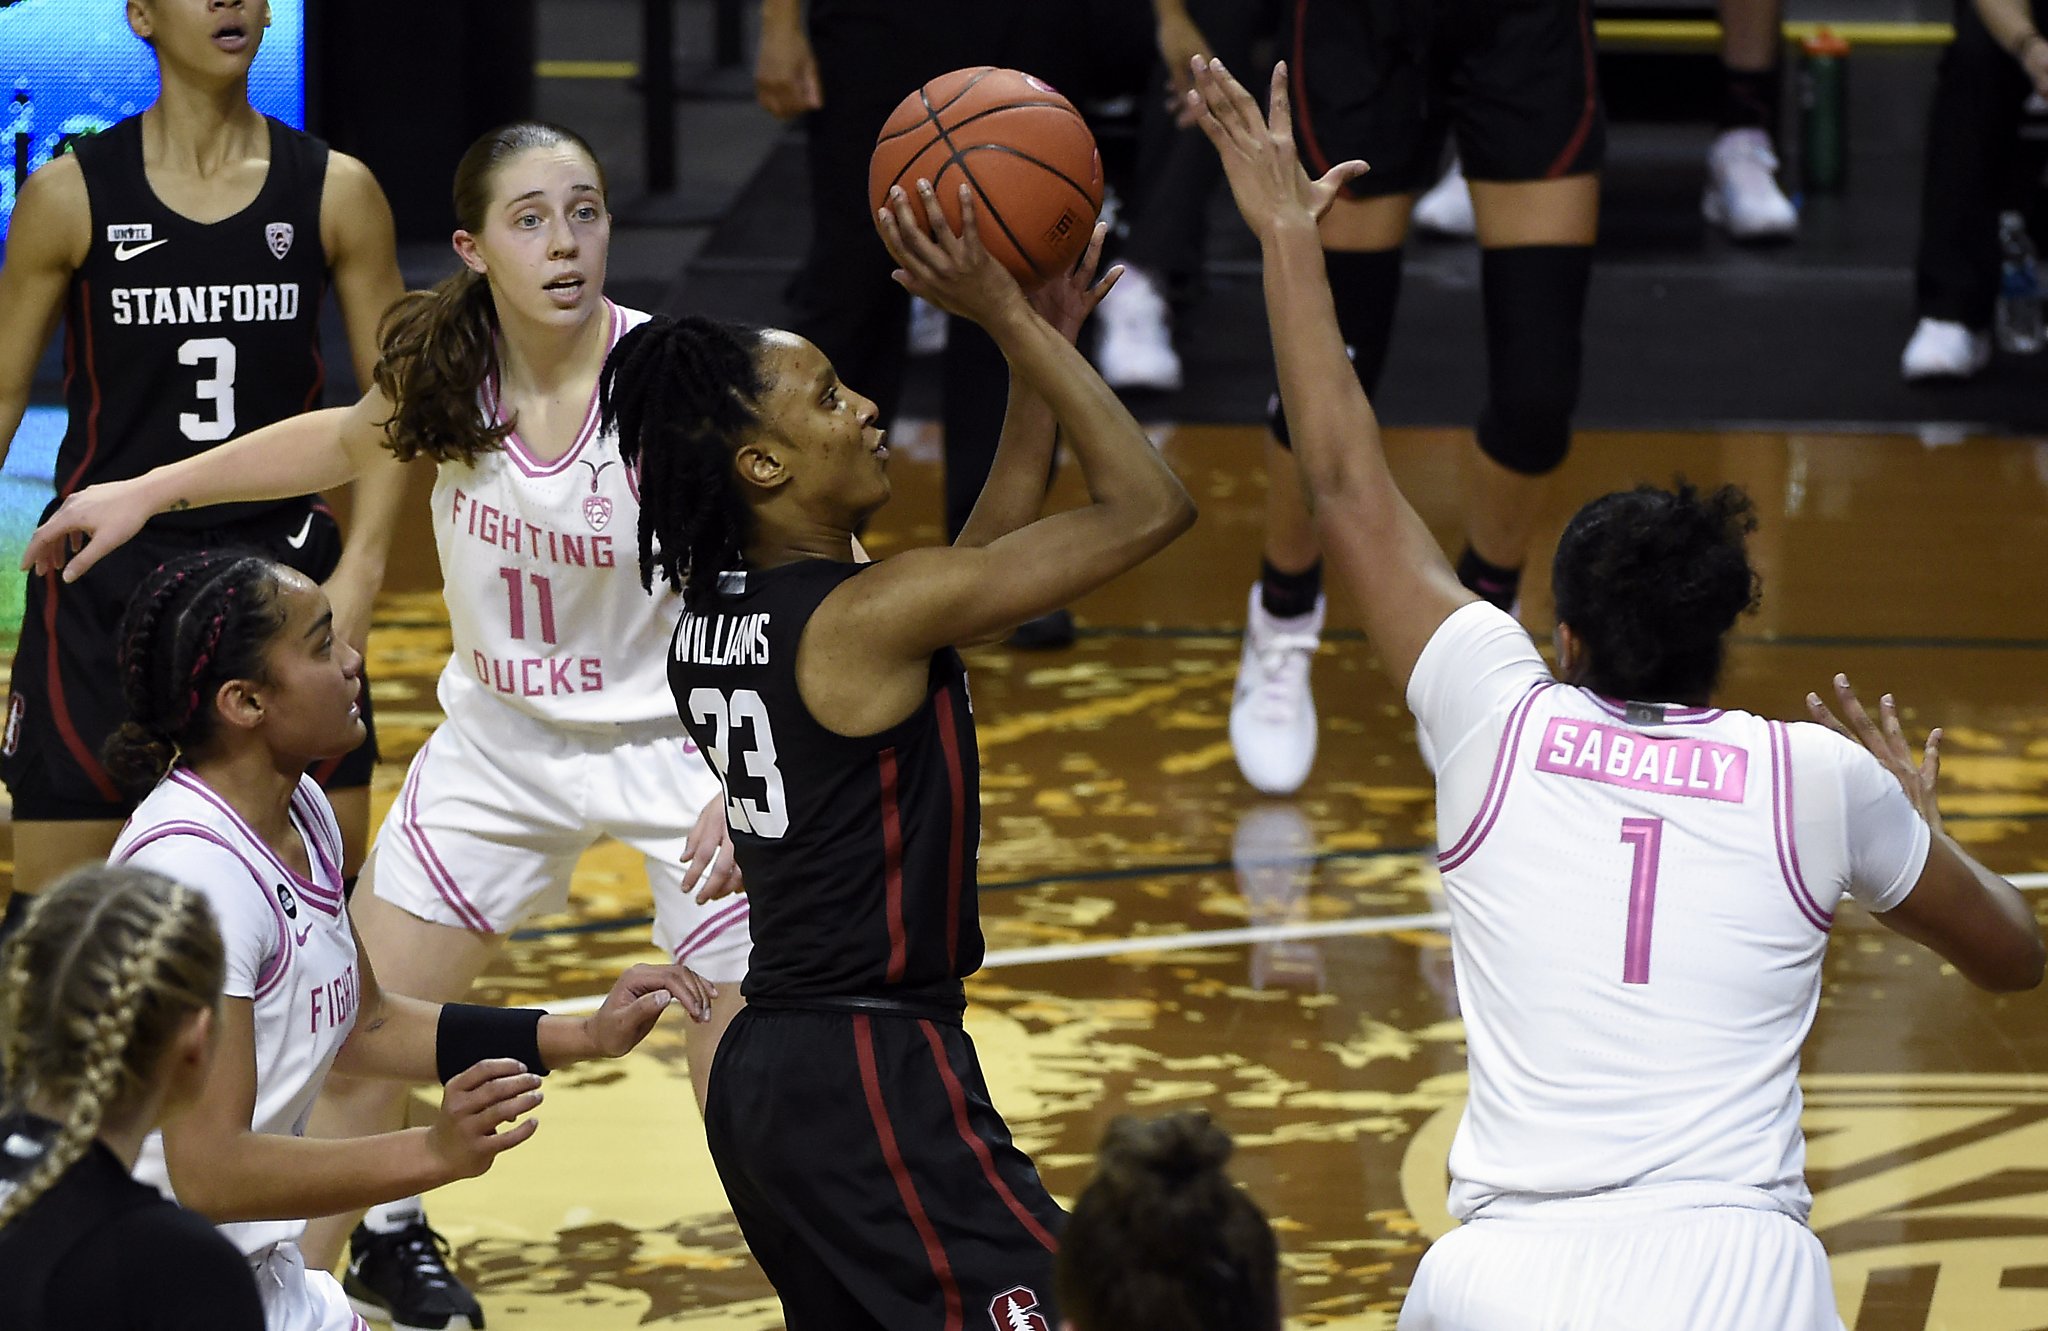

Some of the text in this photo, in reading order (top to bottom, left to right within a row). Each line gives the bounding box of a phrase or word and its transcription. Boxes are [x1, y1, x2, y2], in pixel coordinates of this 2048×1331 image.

[111, 283, 300, 325] STANFORD
[177, 337, 237, 442] 3
[452, 488, 616, 569] FIGHTING
[500, 568, 556, 645] 11
[675, 609, 770, 666] WILLIAMS
[473, 648, 602, 697] DUCKS
[688, 687, 789, 839] 23
[1548, 723, 1737, 791] SABALLY
[1620, 817, 1664, 985] 1
